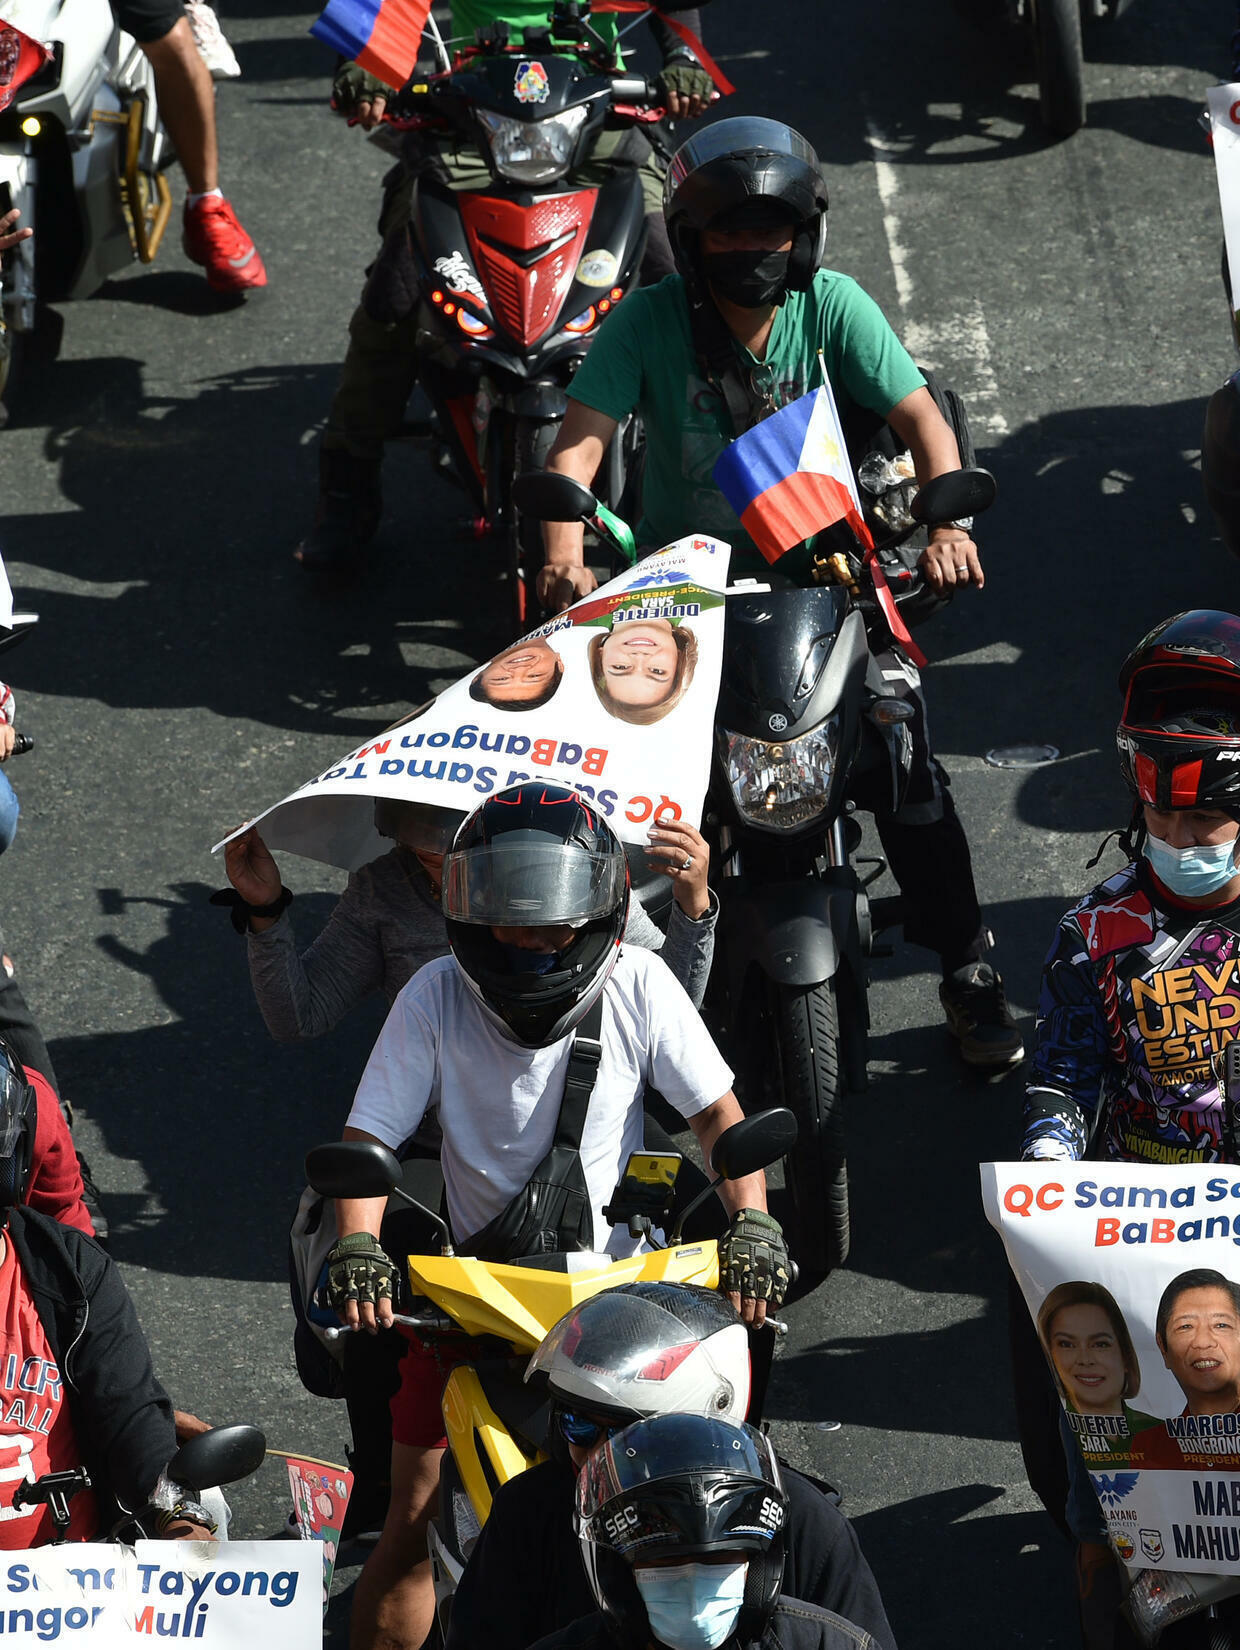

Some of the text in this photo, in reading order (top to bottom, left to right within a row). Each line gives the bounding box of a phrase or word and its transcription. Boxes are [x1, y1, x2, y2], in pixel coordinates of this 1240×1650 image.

[612, 603, 701, 625] DUTERTE
[641, 595, 674, 608] SARA
[399, 724, 609, 778] BaBangon
[378, 758, 498, 793] Sama
[624, 794, 683, 823] QC
[1124, 1132, 1205, 1164] YAYABANGIN
[1003, 1182, 1065, 1218] QC
[1074, 1180, 1196, 1209] Sama
[1065, 1410, 1131, 1437] UTERTE
[1080, 1434, 1111, 1453] SARA
[1082, 1451, 1145, 1463] PRESIDENT
[605, 1505, 639, 1538] SEC
[760, 1496, 784, 1526] SEC
[1103, 1510, 1138, 1521] LAYANG
[136, 1563, 300, 1607] Tayong
[134, 1602, 209, 1638] Muli
